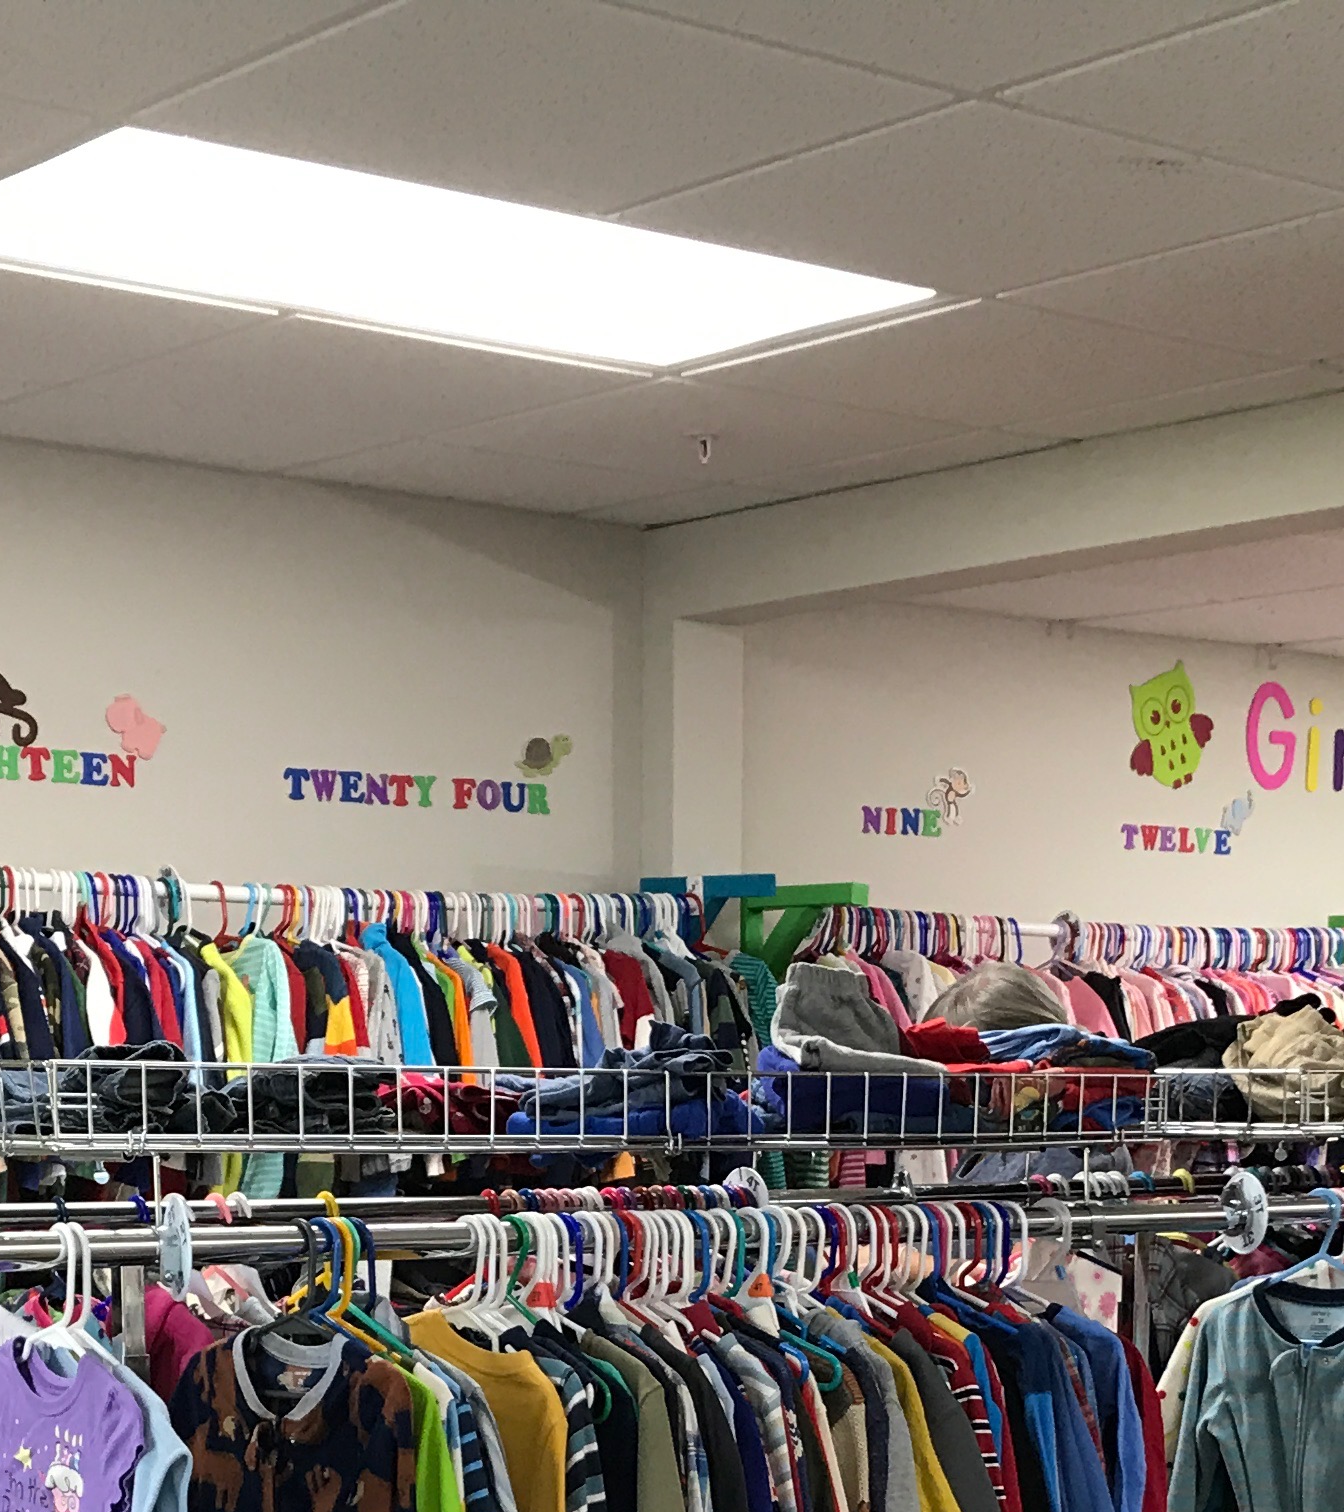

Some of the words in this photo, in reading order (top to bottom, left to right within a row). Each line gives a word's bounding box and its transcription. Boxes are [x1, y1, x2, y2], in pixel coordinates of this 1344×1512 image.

[284, 767, 435, 808] TWENTY
[451, 778, 550, 815] FOUR
[861, 806, 942, 838] NINE
[1121, 823, 1233, 857] TWELVE
